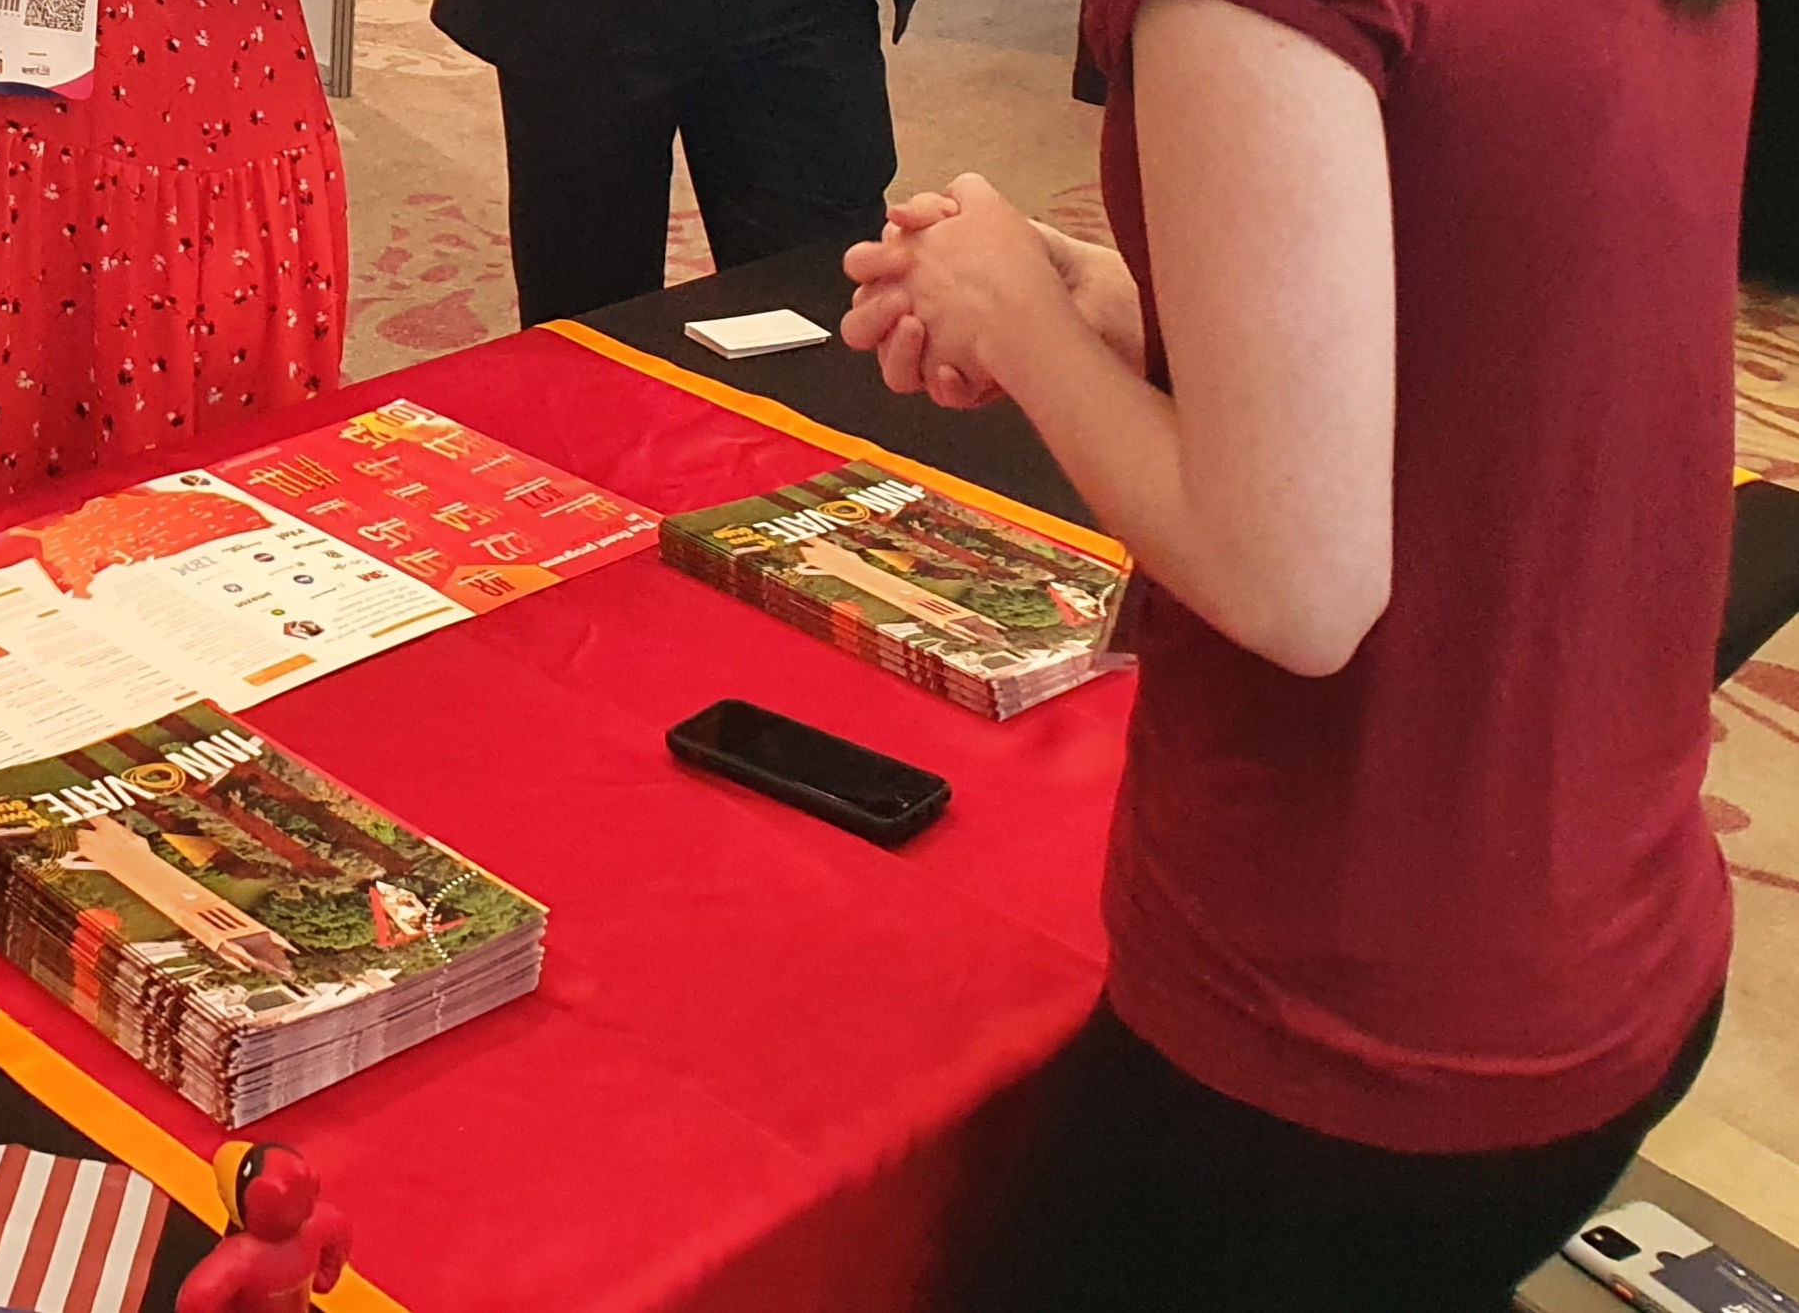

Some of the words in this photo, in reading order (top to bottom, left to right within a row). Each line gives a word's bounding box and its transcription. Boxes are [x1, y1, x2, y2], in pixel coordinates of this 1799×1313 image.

[753, 479, 927, 544] INNOVATE
[170, 554, 219, 576] IBM
[30, 728, 265, 825] INNOVATE
